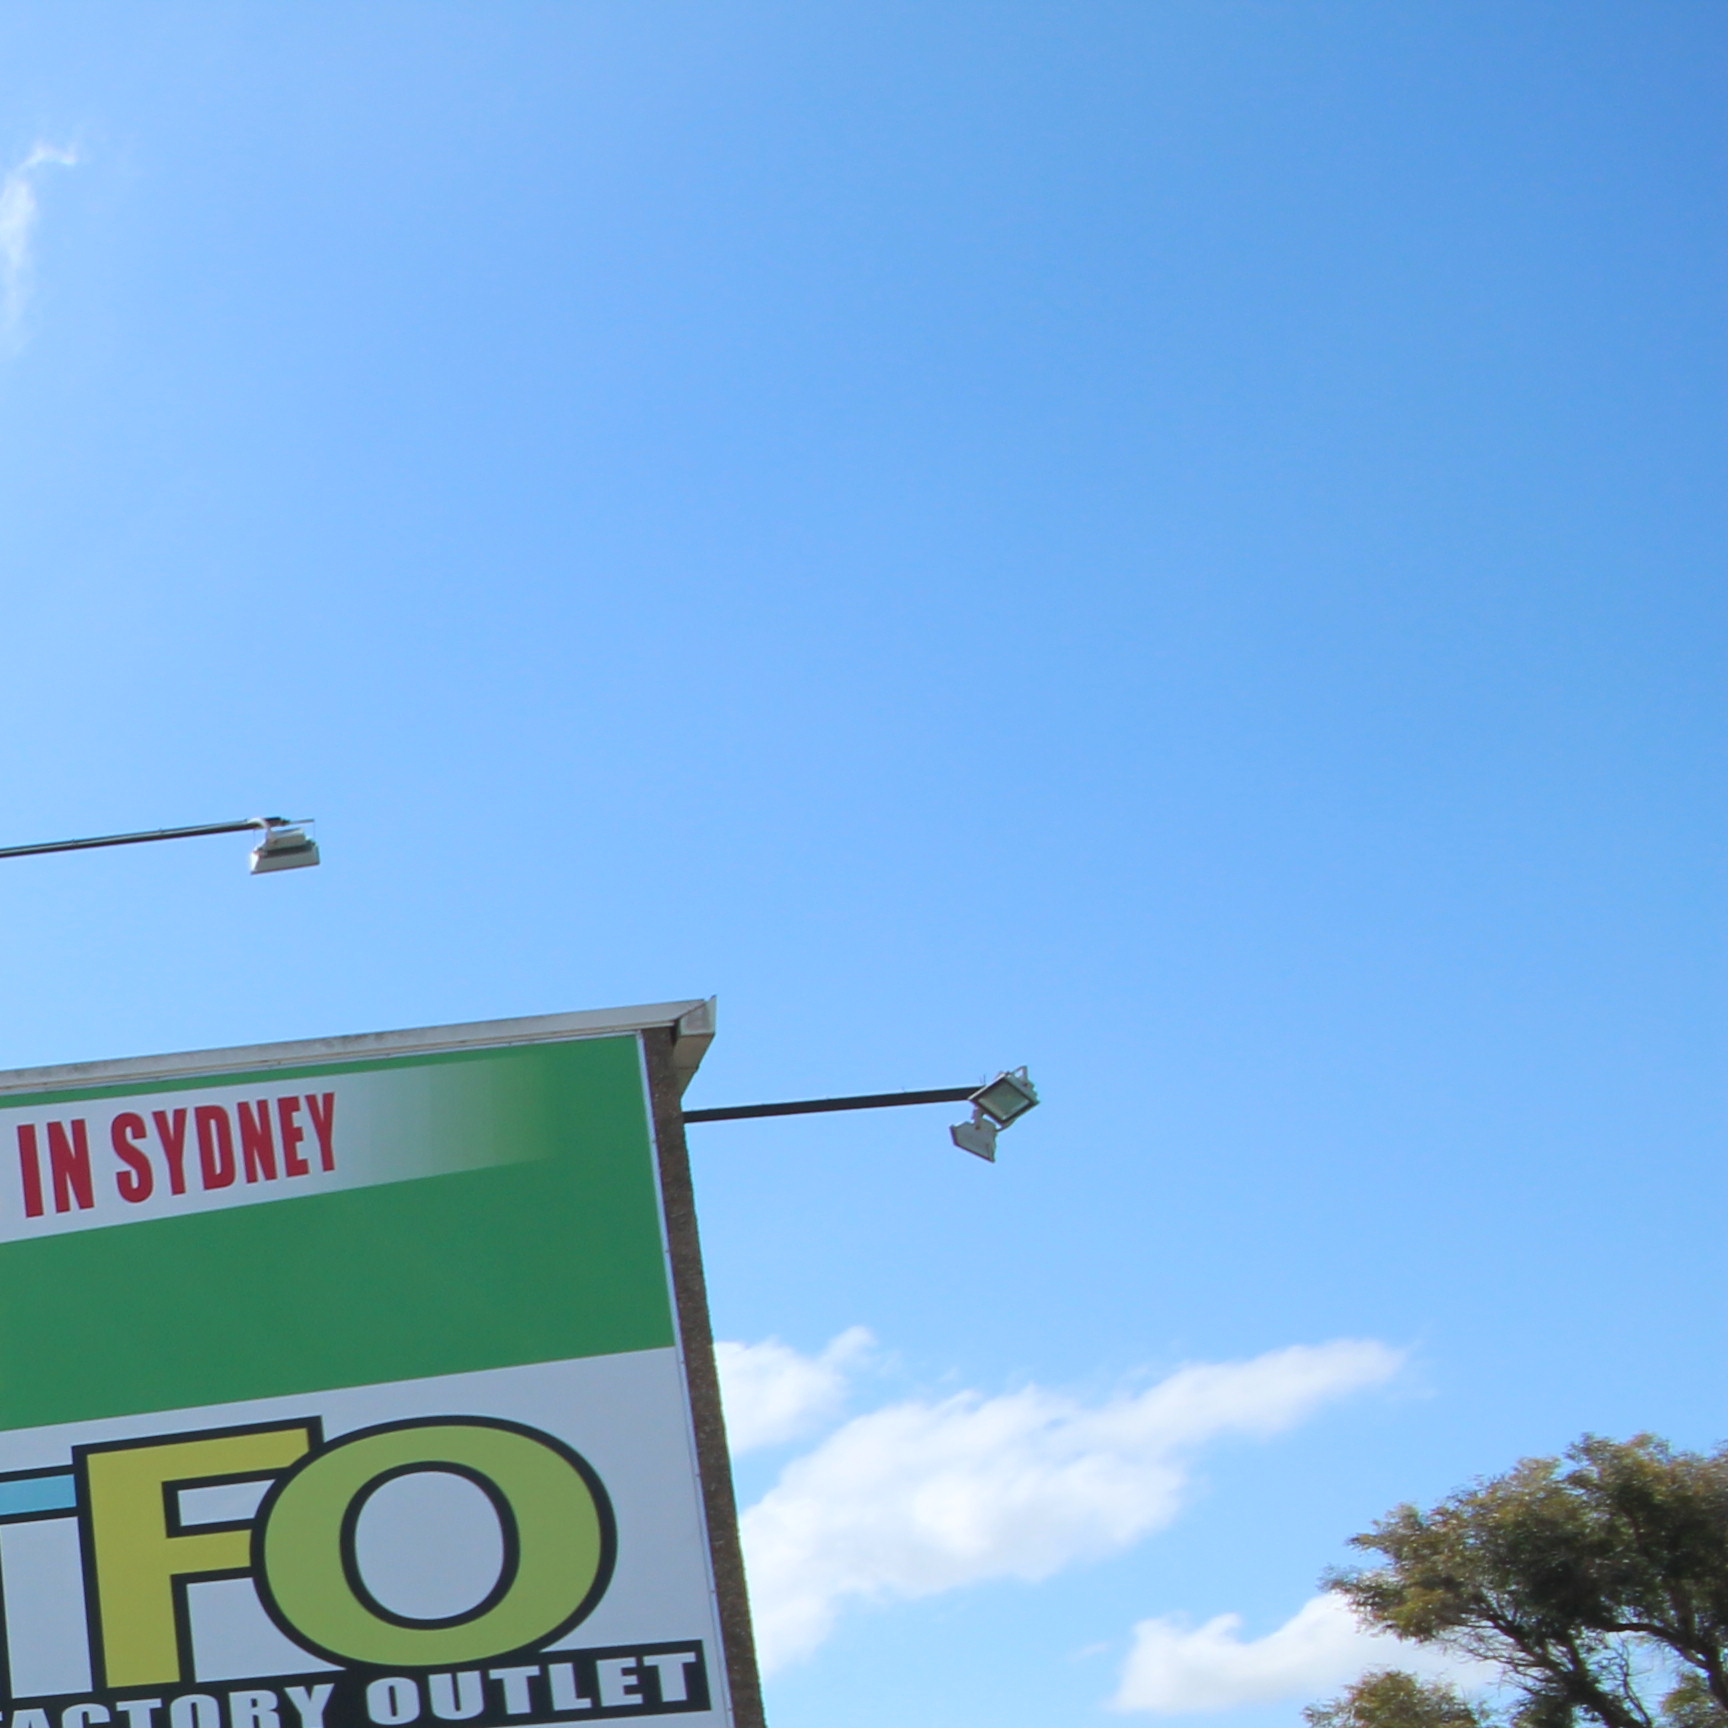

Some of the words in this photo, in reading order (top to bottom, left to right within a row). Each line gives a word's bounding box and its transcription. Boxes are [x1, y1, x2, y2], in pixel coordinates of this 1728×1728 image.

[19, 1118, 96, 1219] IN
[113, 1091, 336, 1204] SYDNEY
[366, 1650, 699, 1726] OUTLET
